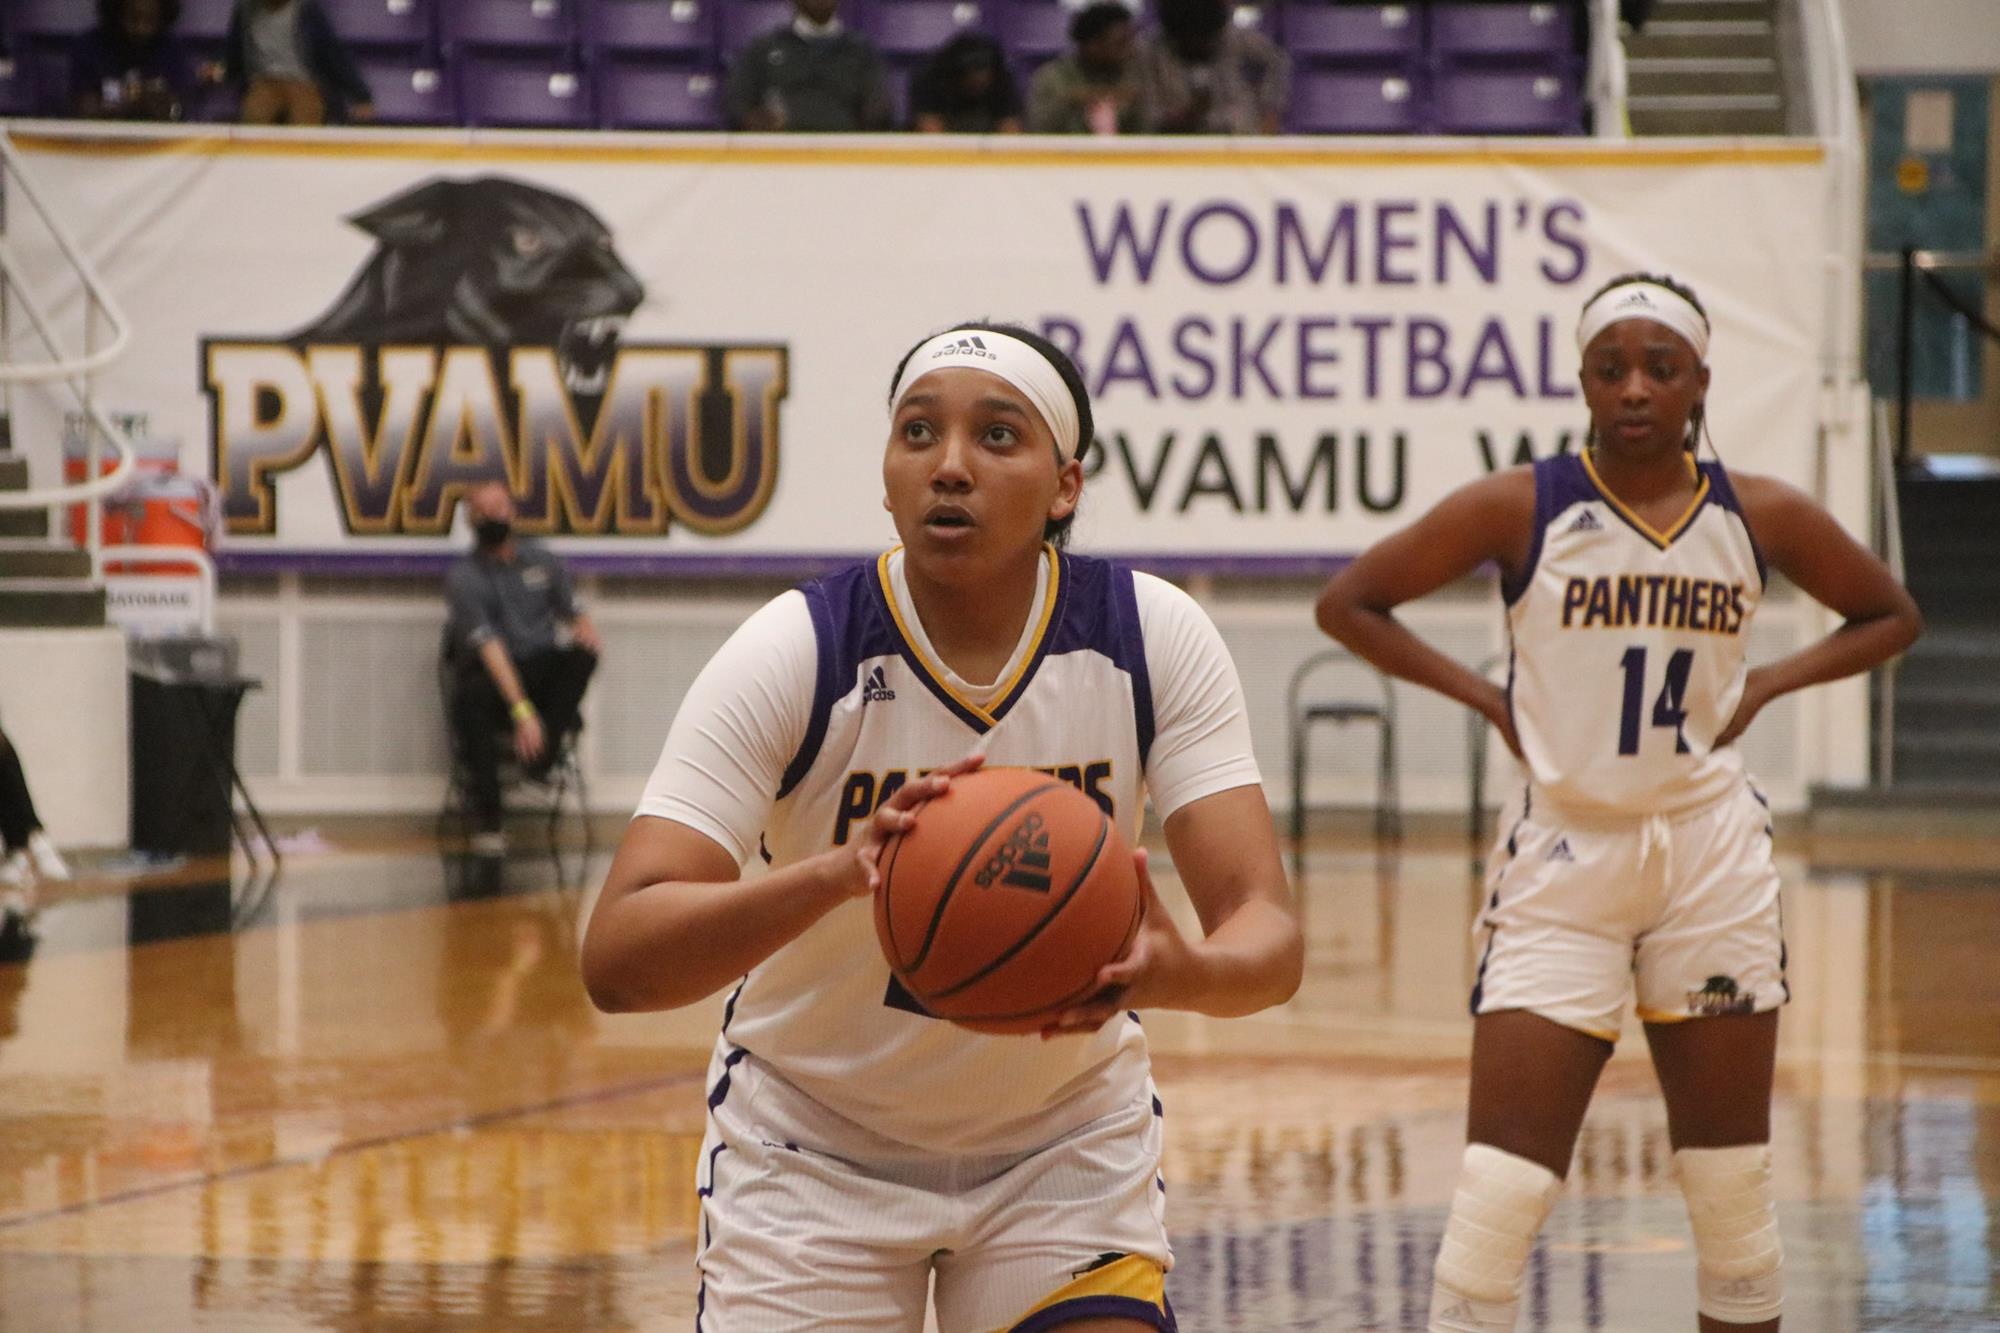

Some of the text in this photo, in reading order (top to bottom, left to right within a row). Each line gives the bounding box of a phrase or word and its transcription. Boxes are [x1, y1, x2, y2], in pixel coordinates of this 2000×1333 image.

[1077, 199, 1590, 285] WOMEN'S
[931, 345, 998, 361] adidas
[1040, 316, 1577, 400] ASKETBAL
[199, 338, 788, 536] PVAMU
[1084, 432, 1408, 512] VAMU
[1562, 575, 1745, 636] PANTHERS
[1618, 645, 1696, 756] 14
